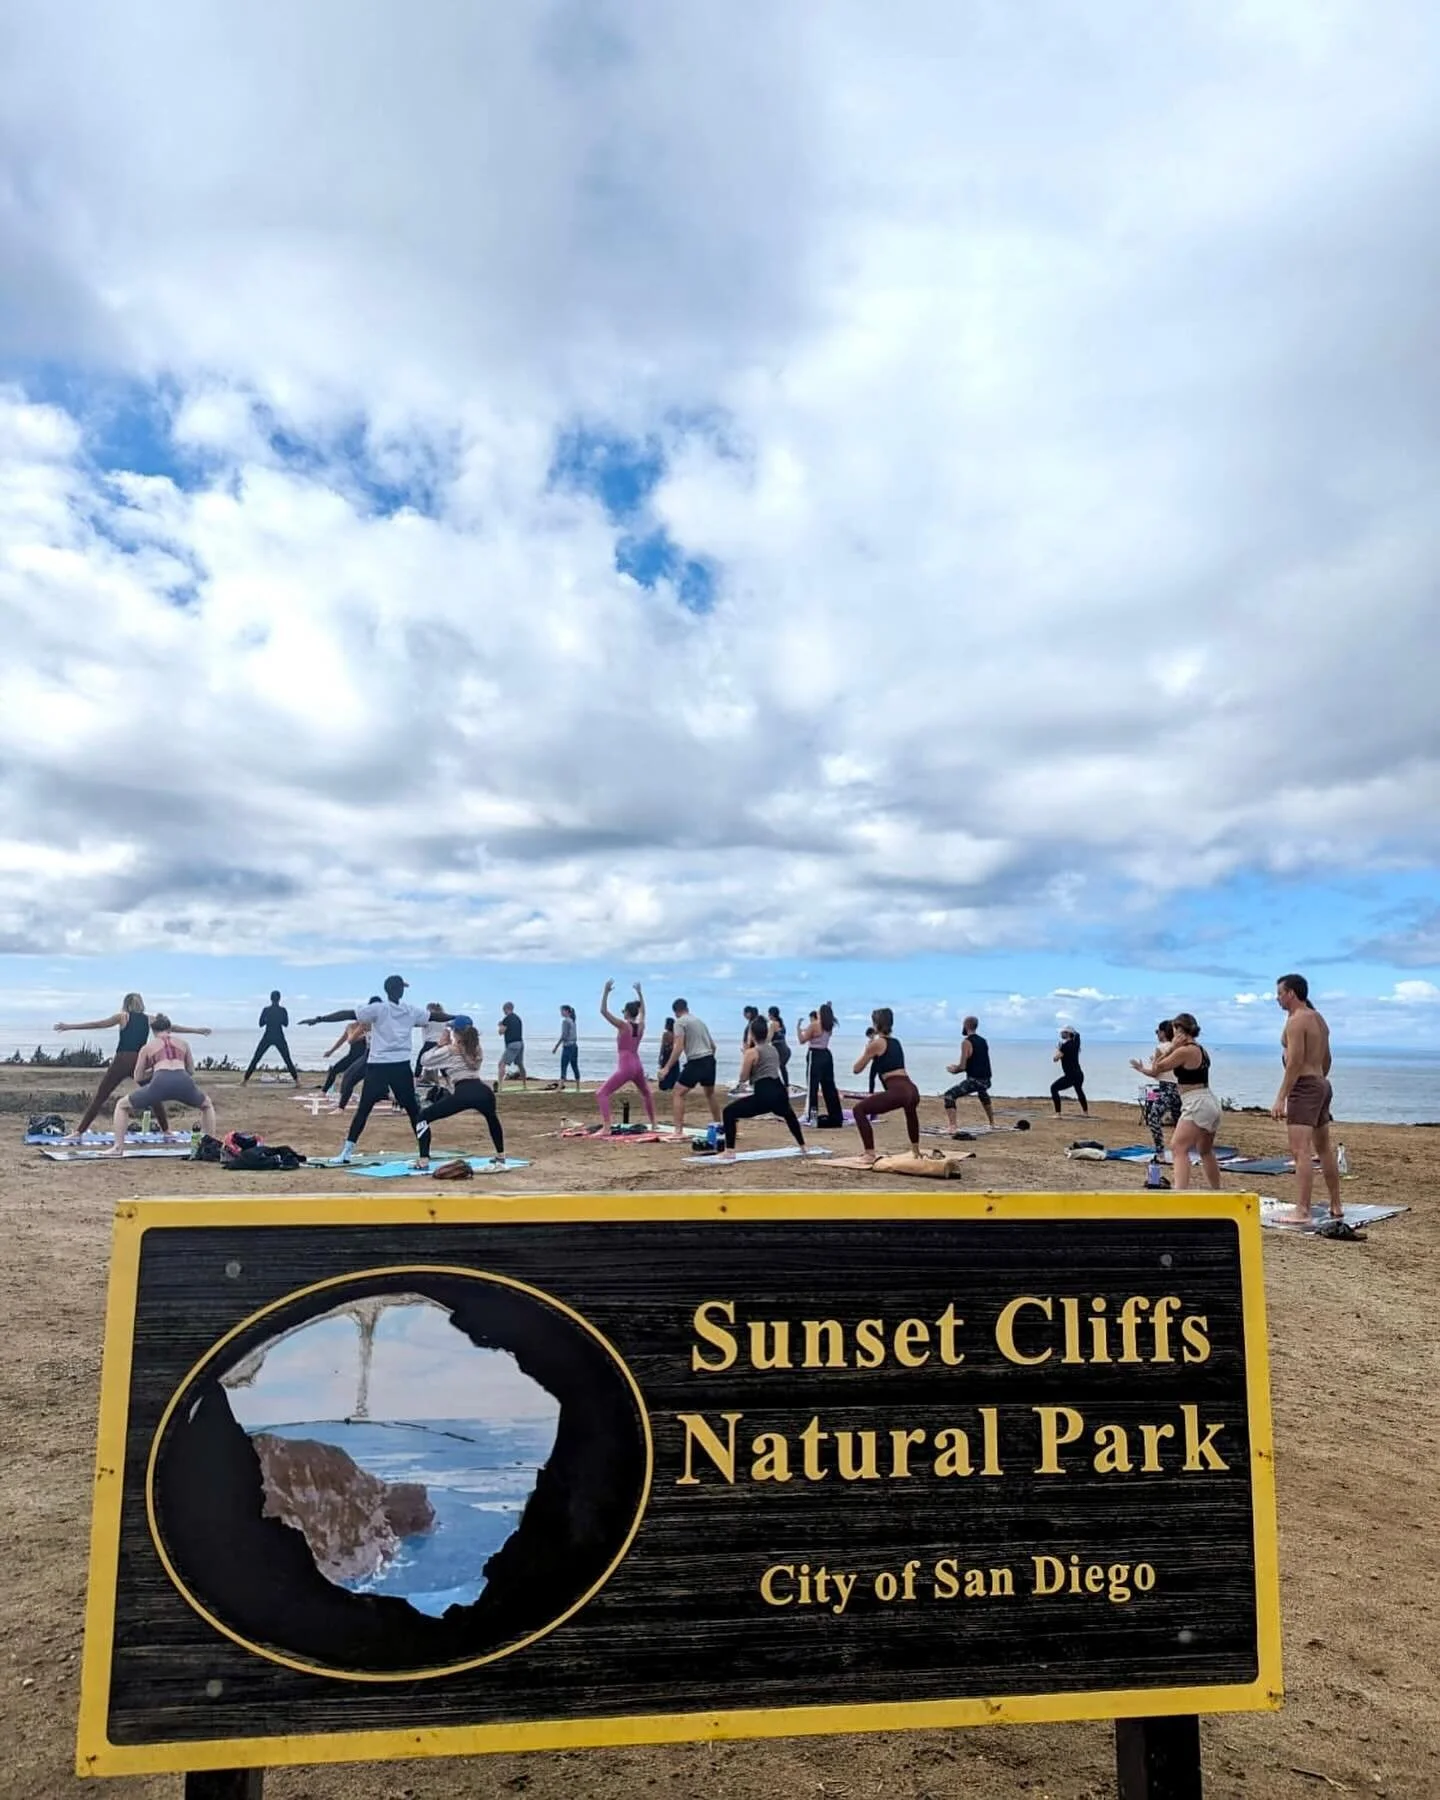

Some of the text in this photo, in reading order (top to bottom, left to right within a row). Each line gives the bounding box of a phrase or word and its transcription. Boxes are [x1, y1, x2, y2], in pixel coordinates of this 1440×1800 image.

[692, 1295, 1211, 1372] Sunset Cliffs
[676, 1404, 1229, 1485] Natural Park
[760, 1555, 1156, 1613] City of San Diego
